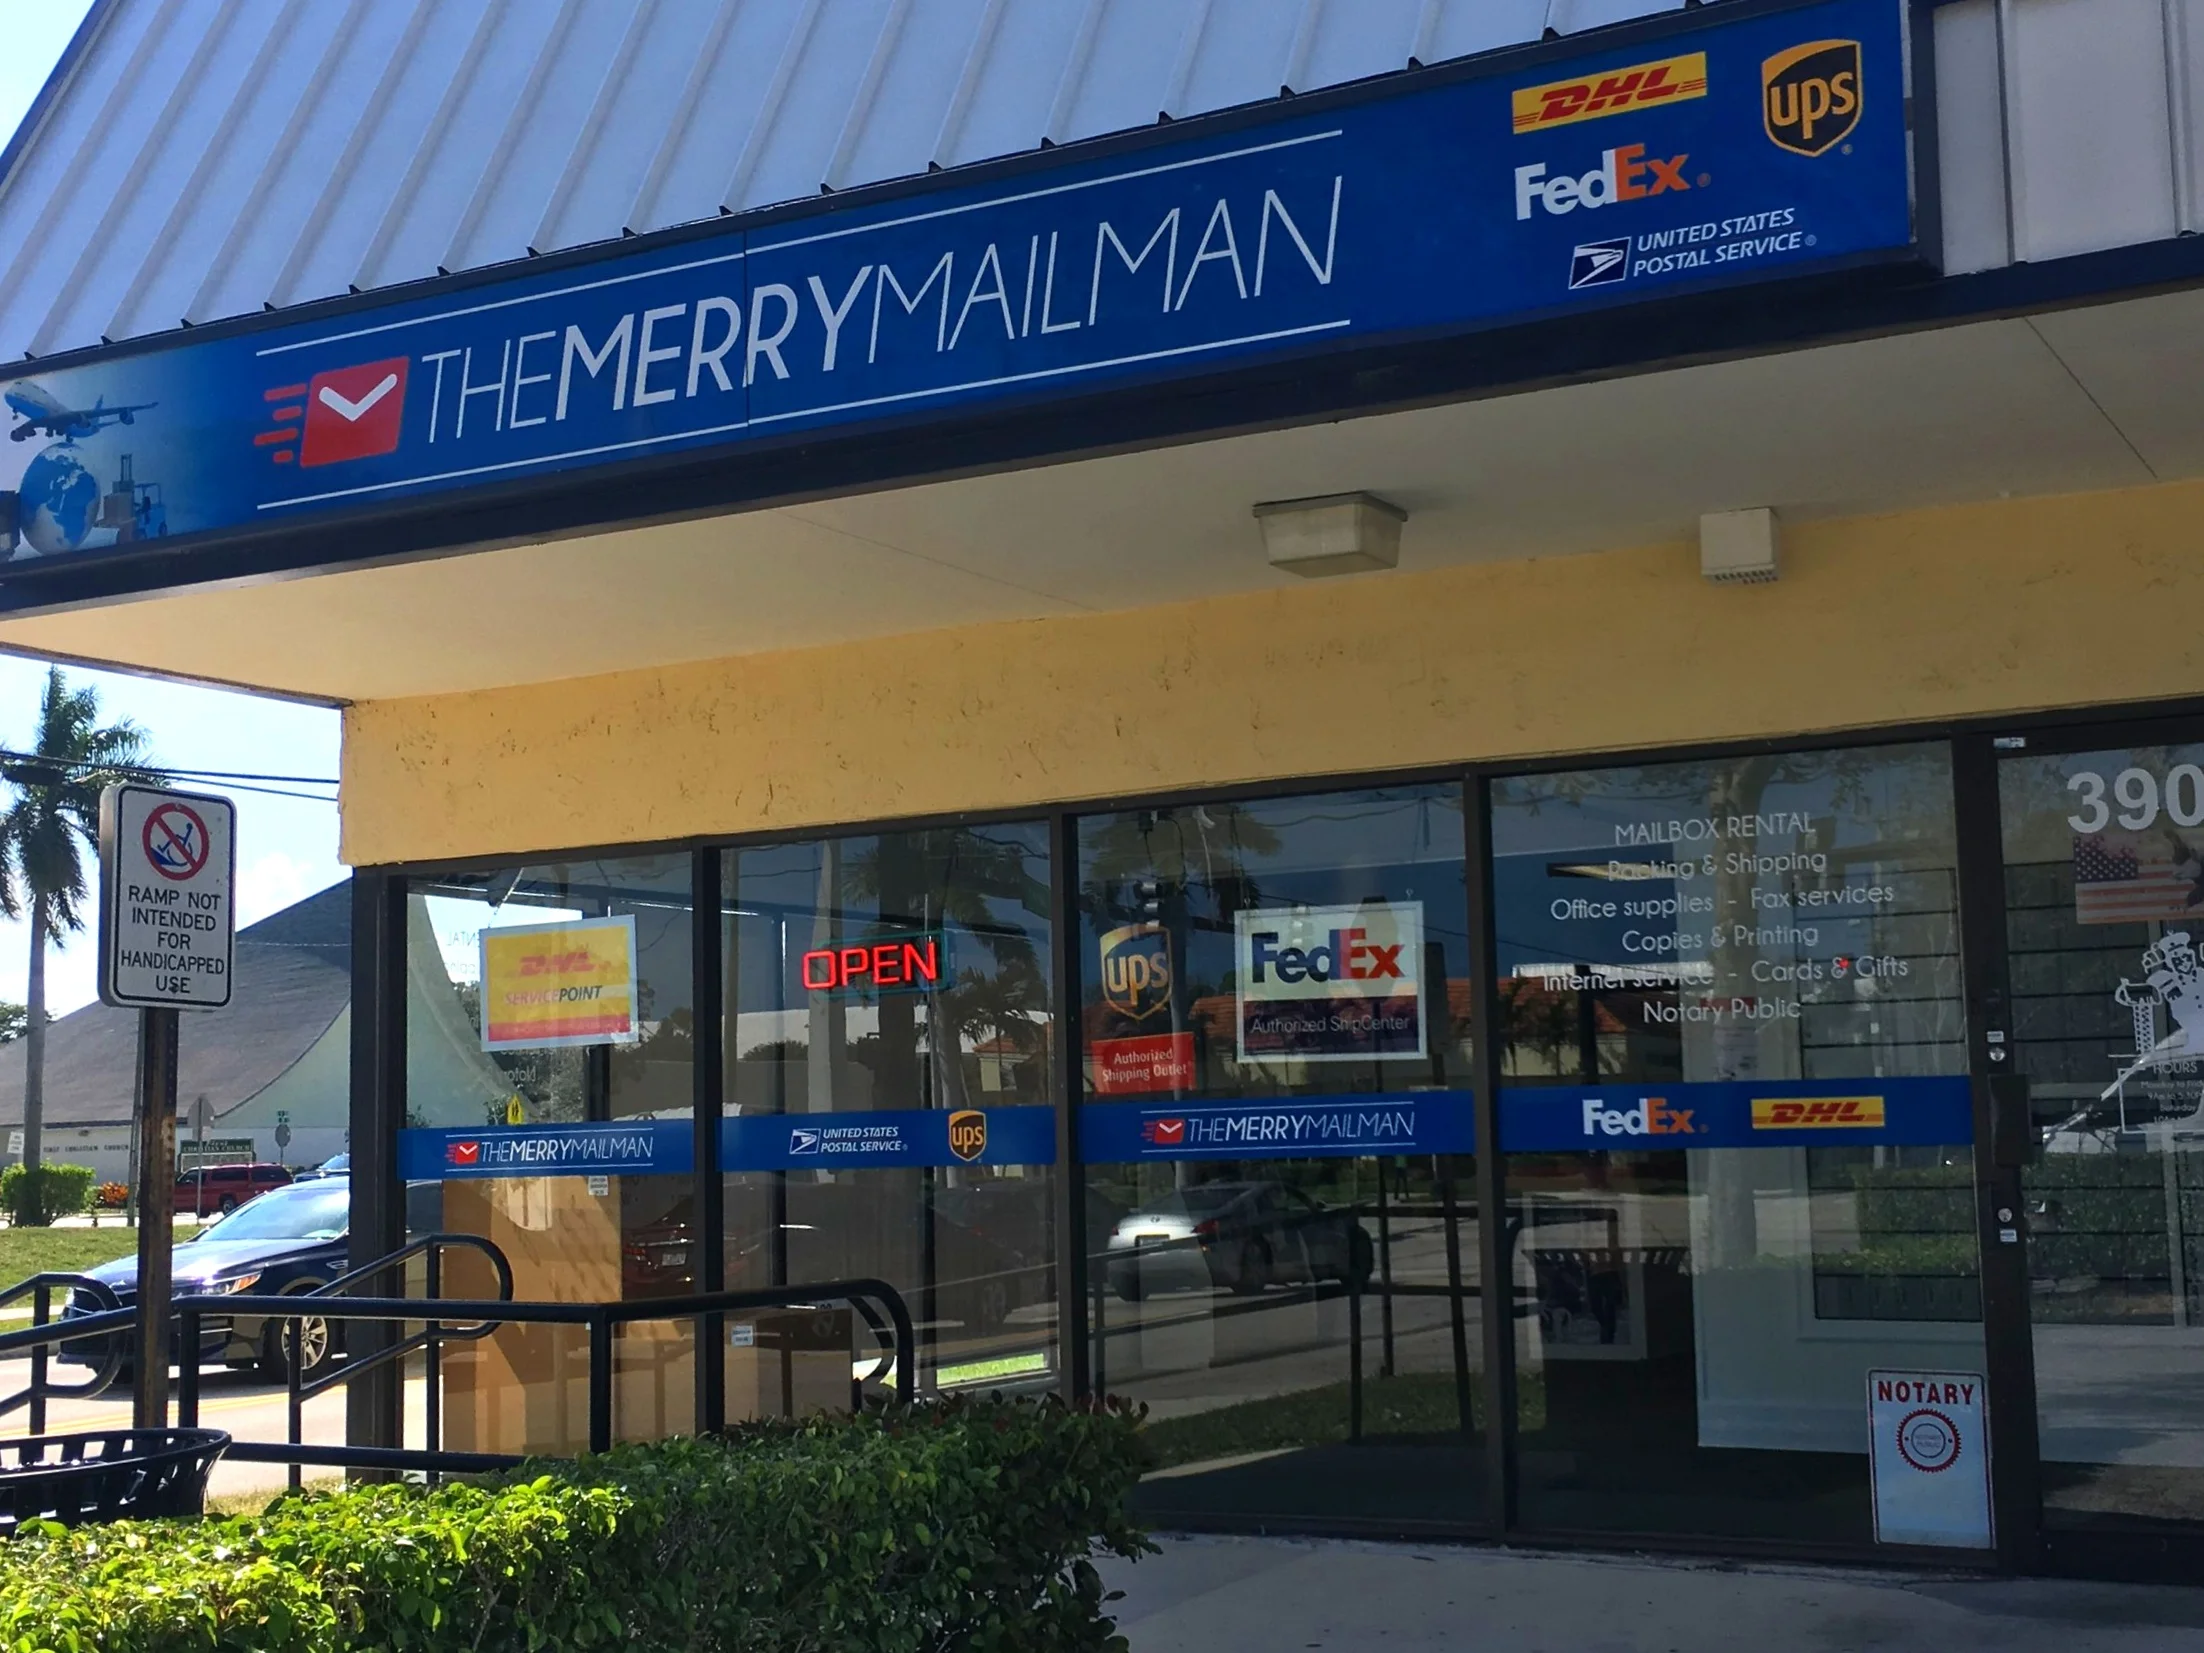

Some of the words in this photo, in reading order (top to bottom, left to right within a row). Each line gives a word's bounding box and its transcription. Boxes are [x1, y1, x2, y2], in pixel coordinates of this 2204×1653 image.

[1539, 66, 1678, 121] DHL
[1769, 70, 1856, 140] ups
[1514, 143, 1691, 221] FedEx
[1637, 223, 1717, 253] UNITED
[1719, 207, 1796, 238] STATES
[1633, 245, 1711, 278] POSTAL
[1714, 231, 1802, 264] SERVICE
[2066, 763, 2204, 834] 390
[1614, 818, 1719, 847] MAILBOX
[1727, 811, 1816, 839] RENTAL
[1608, 858, 1696, 882] Packing
[1702, 854, 1718, 875] &
[1725, 851, 1827, 877] Shipping
[128, 885, 180, 906] RAMP
[188, 891, 221, 911] NOT
[1550, 897, 1617, 922] Office
[1623, 892, 1714, 918] supplies
[1750, 887, 1793, 910] Fax
[1797, 883, 1894, 906] services
[132, 906, 216, 932] INTENDED
[158, 931, 191, 951] FOR
[1622, 929, 1703, 955] Copies
[1710, 927, 1726, 948] &
[1734, 924, 1819, 948] Printing
[121, 950, 225, 976] HANDICAPPED
[802, 941, 938, 991] OPEN
[1251, 927, 1406, 984] FedEx
[155, 975, 191, 994] USE
[1107, 952, 1169, 1007] ups
[1543, 969, 1626, 993] Internet
[1751, 958, 1823, 983] Cards
[1831, 956, 1849, 979] &
[1855, 955, 1909, 979] Gifts
[1250, 1016, 1327, 1034] Authorized
[1643, 1001, 1723, 1026] Notary
[1731, 998, 1803, 1021] Public
[1113, 1047, 1174, 1065] Authorized
[1102, 1063, 1151, 1083] Shipping
[1153, 1062, 1188, 1078] Outlet
[1582, 1097, 1695, 1136] FedEx
[1769, 1101, 1867, 1124] DHL
[820, 1141, 859, 1153] POSTAL
[859, 1140, 902, 1152] SERVICE
[822, 1127, 863, 1139] UNITED
[863, 1126, 899, 1138] STATES
[951, 1125, 984, 1153] ups
[1877, 1380, 1975, 1405] NOTARY
